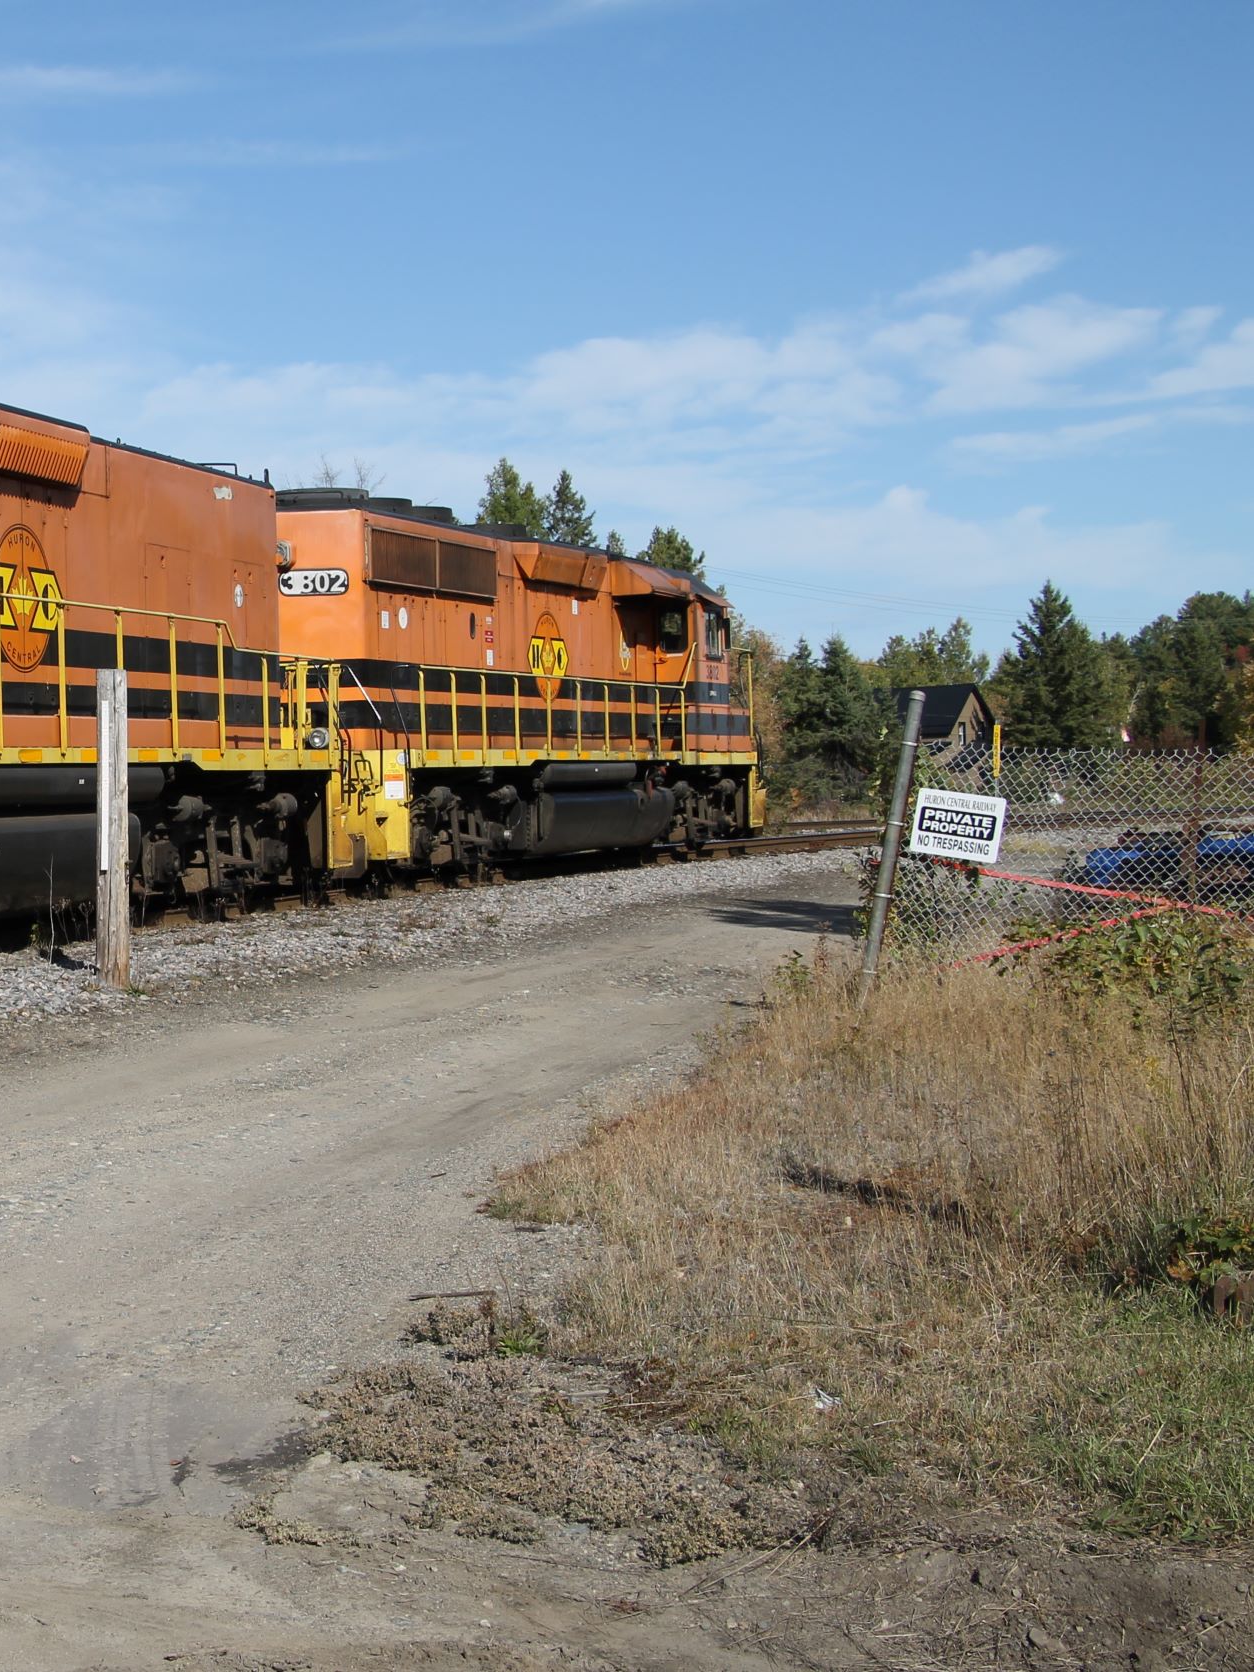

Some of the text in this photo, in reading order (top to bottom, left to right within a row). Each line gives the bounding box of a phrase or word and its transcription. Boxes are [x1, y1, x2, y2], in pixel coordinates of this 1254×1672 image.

[7, 535, 36, 553] HURON
[282, 571, 346, 593] 3802
[6, 641, 41, 665] CENTRAL
[924, 794, 997, 813] HURON CENTRAL RAILWAY
[924, 808, 994, 828] PRIVATE
[921, 819, 992, 839] PROPERTY
[916, 834, 990, 856] NO TRESPASSING
